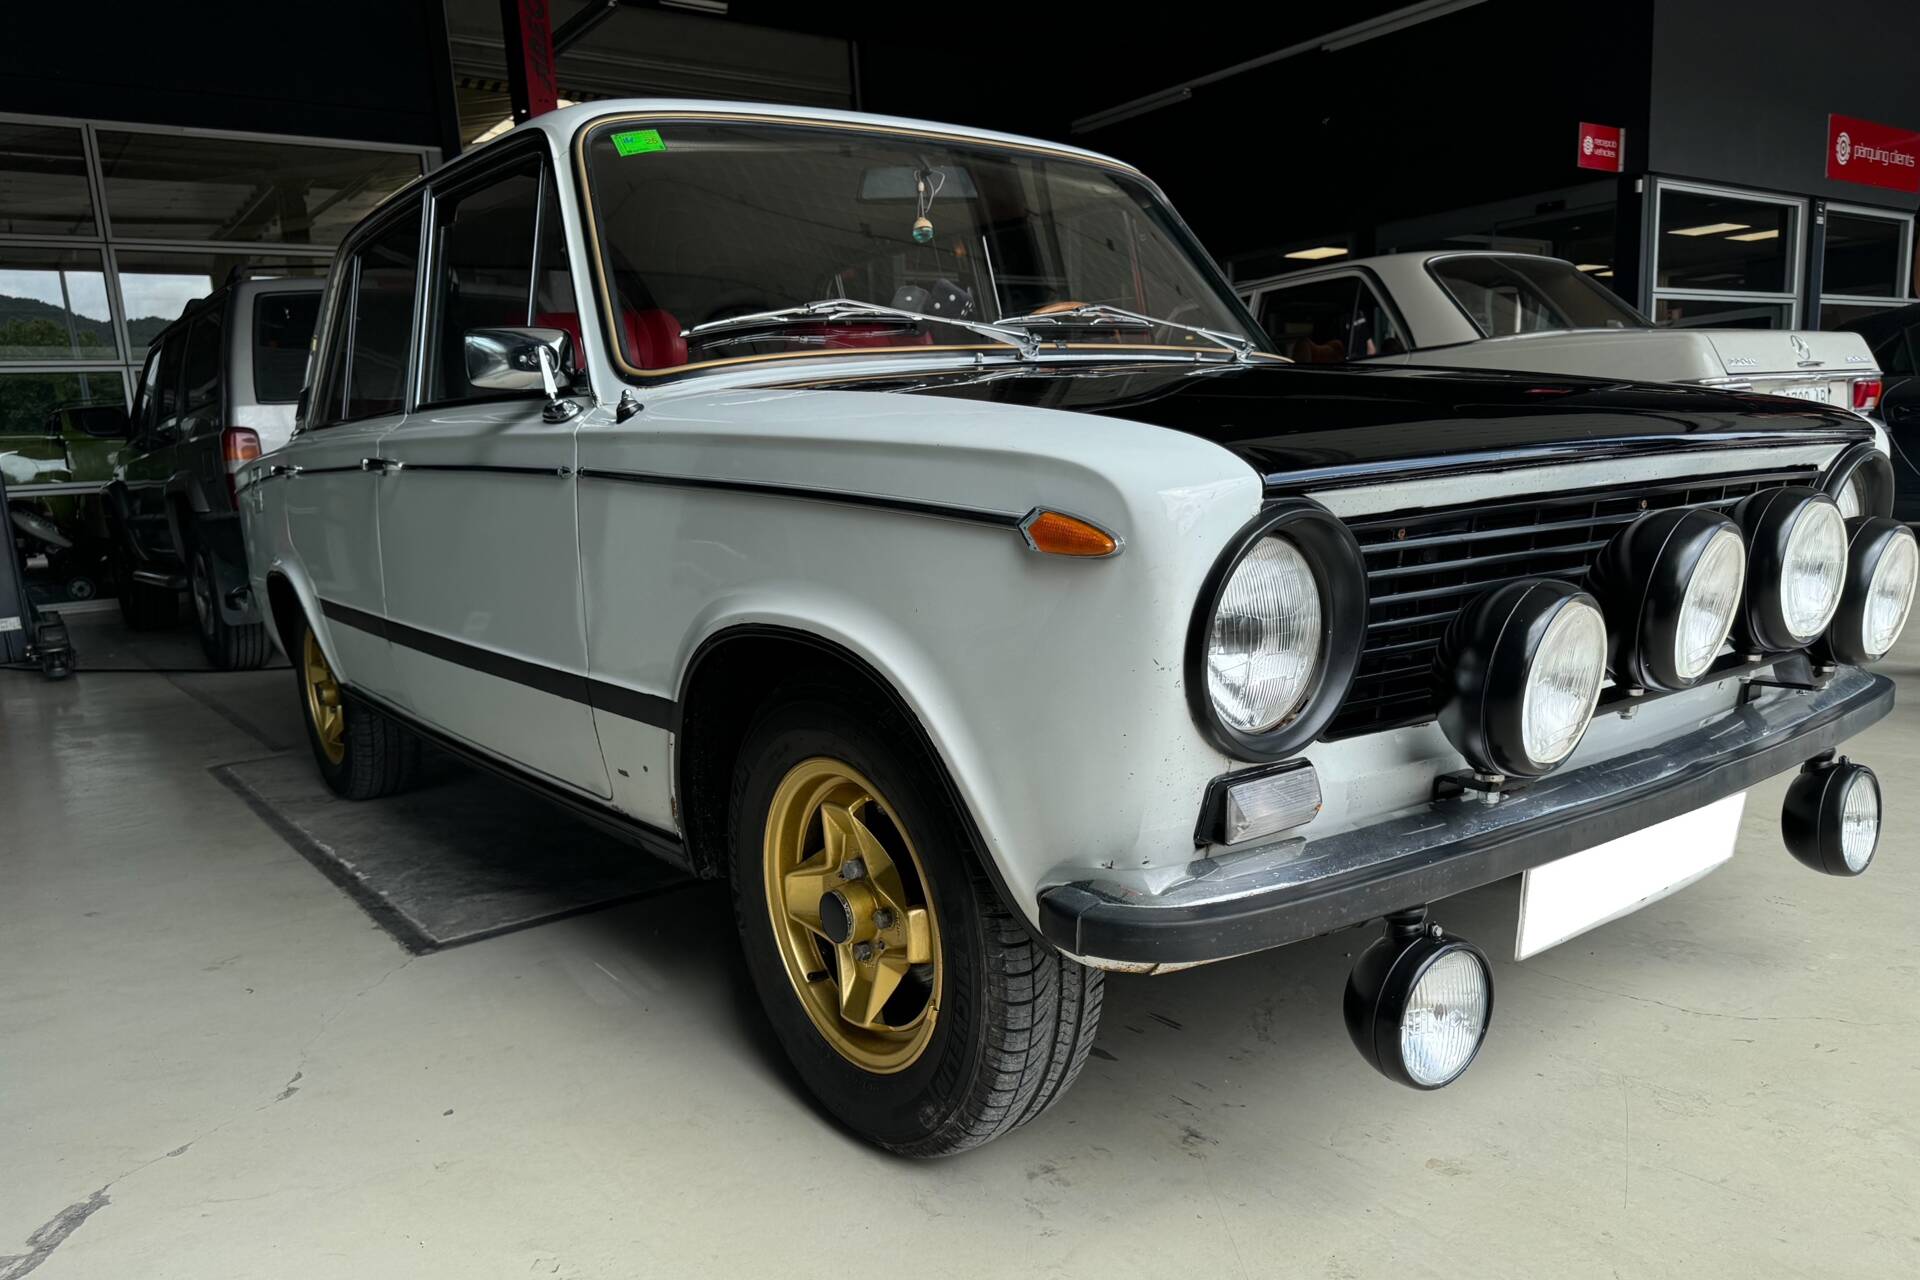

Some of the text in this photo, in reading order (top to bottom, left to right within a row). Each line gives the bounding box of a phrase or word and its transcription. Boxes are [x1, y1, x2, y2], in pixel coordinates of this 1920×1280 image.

[1853, 142, 1915, 168] pàrquing clients
[930, 947, 972, 1103] MICHELIN
